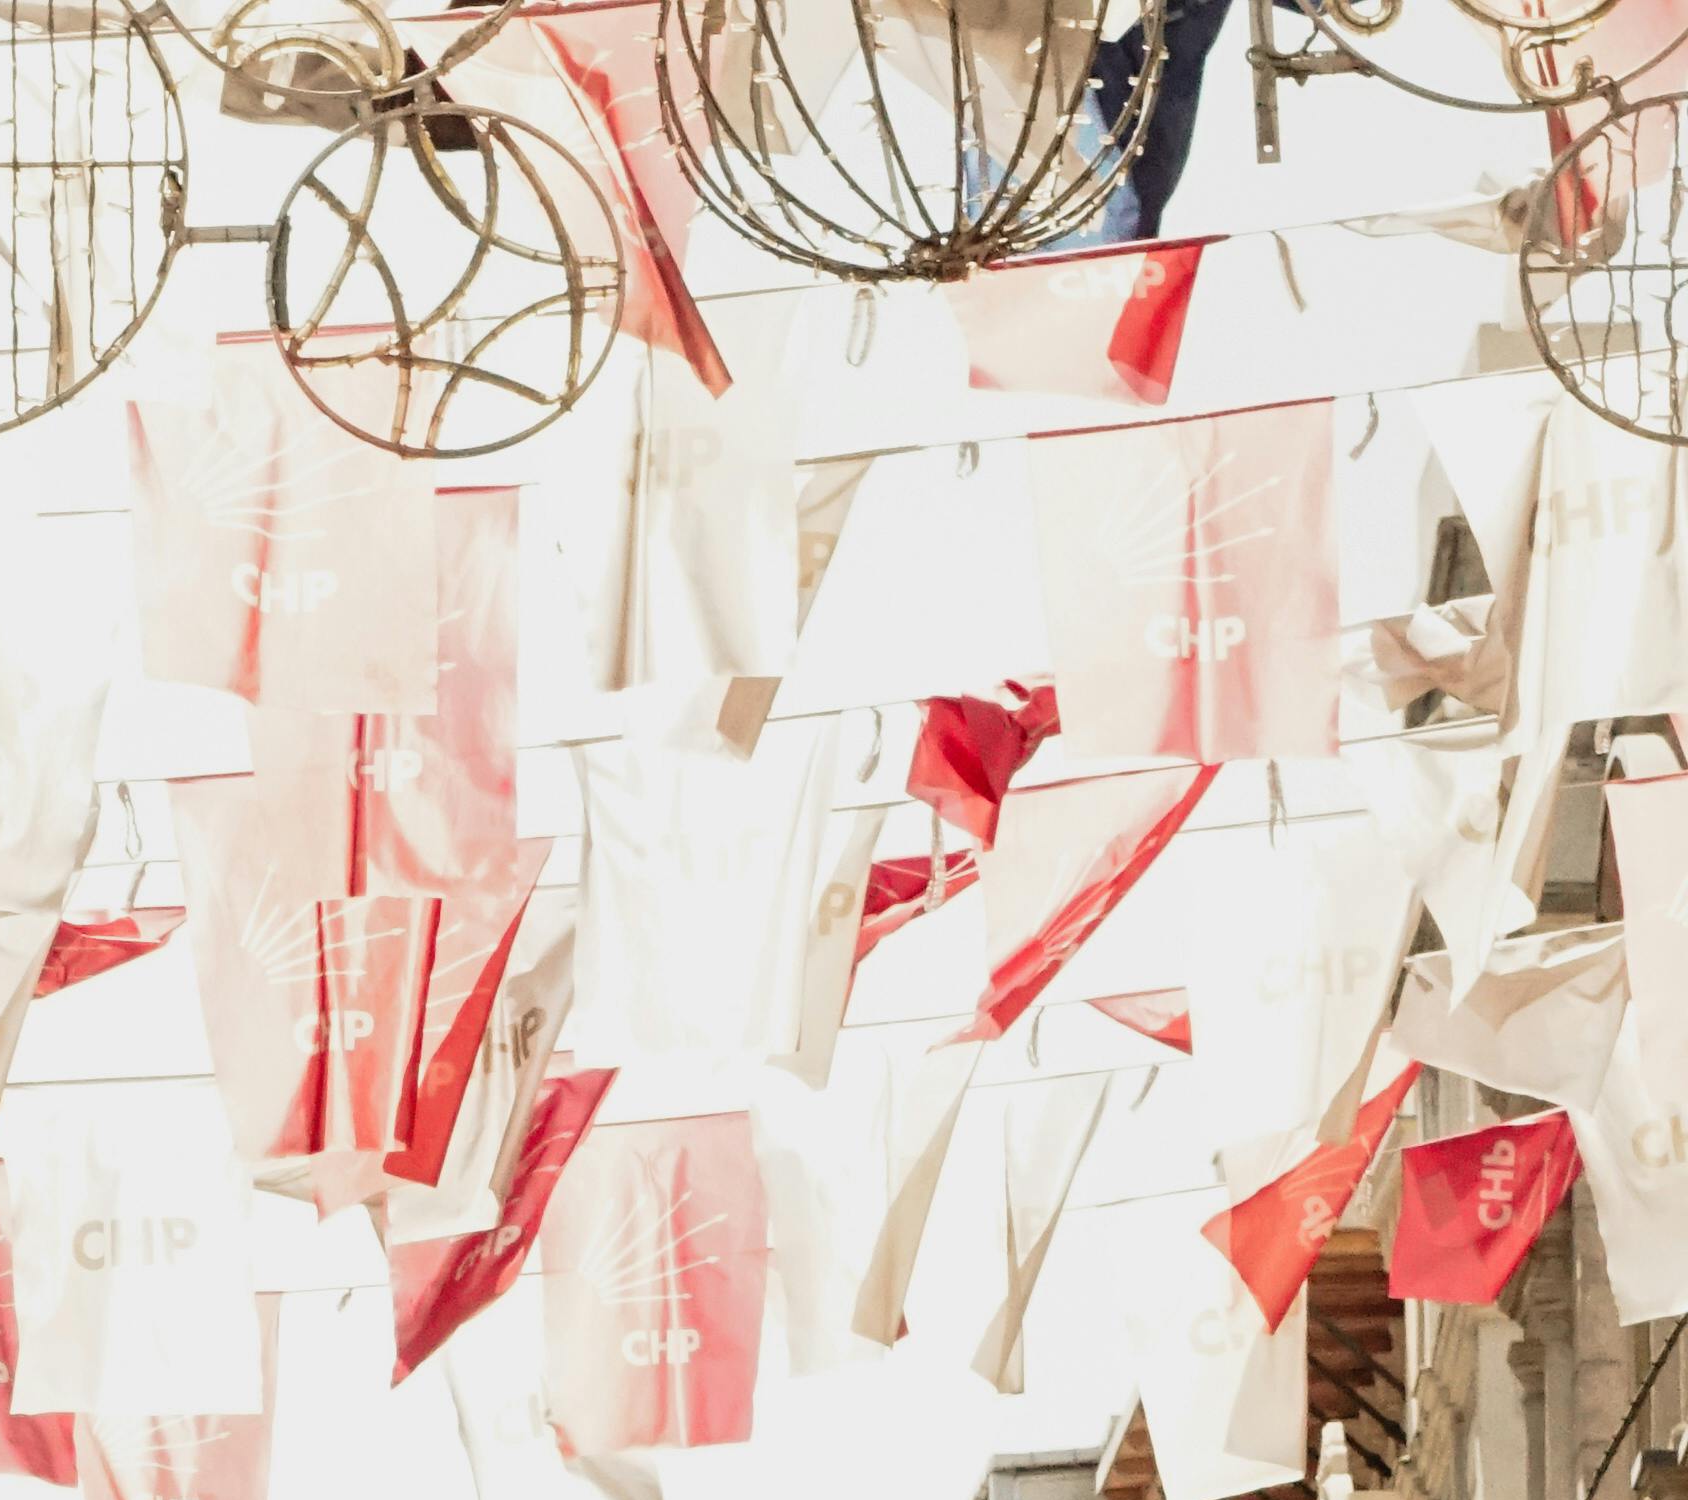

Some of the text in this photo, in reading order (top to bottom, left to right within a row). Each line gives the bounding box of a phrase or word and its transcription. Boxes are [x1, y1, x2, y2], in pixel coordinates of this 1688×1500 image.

[1047, 256, 1168, 302] CHP
[231, 563, 338, 615] CHP
[1144, 615, 1246, 663] CHP
[1478, 1139, 1517, 1229] CHP
[72, 1217, 199, 1272] CHP
[622, 1328, 701, 1367] CHP
